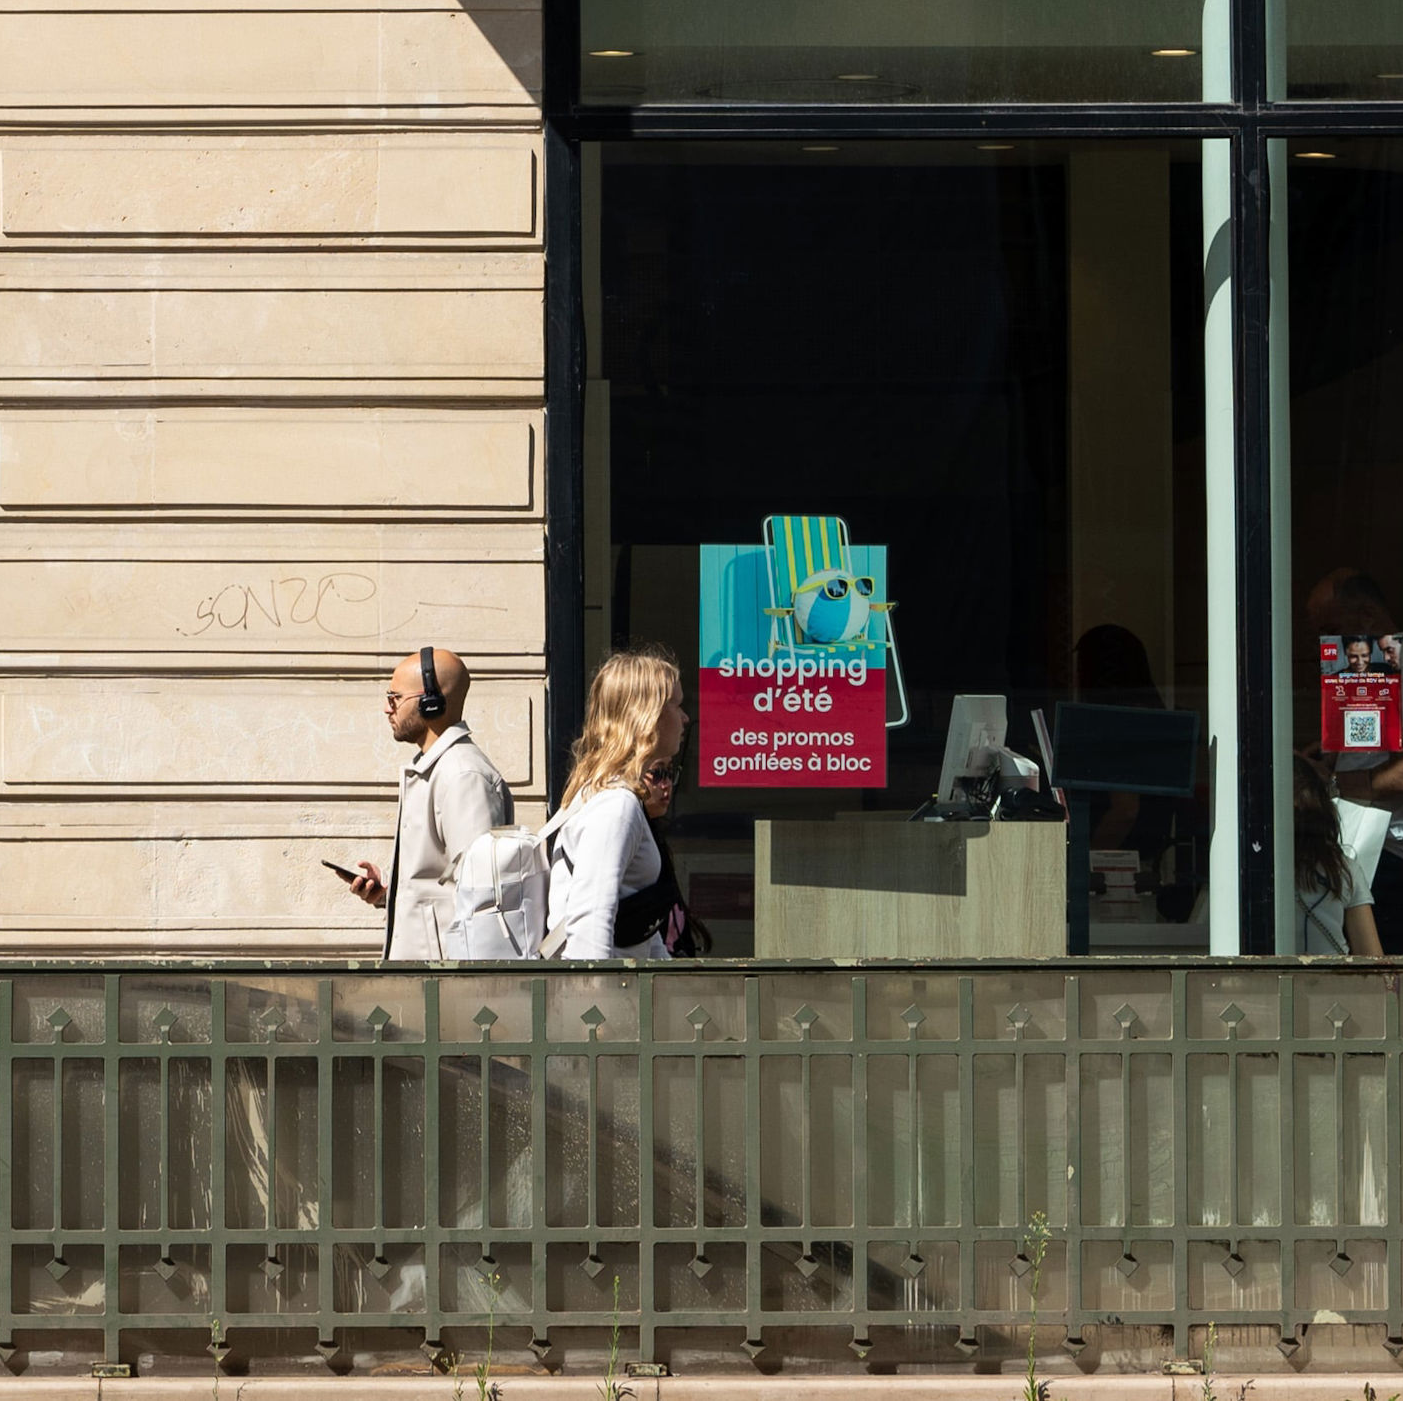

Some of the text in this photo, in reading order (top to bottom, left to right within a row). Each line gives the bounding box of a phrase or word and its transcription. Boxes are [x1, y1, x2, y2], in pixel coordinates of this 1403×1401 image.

[1324, 648, 1337, 656] SFR
[718, 652, 867, 686] shopping
[753, 686, 833, 713] d’été
[730, 728, 855, 751] des promos
[713, 752, 872, 775] gonflées à bloc
